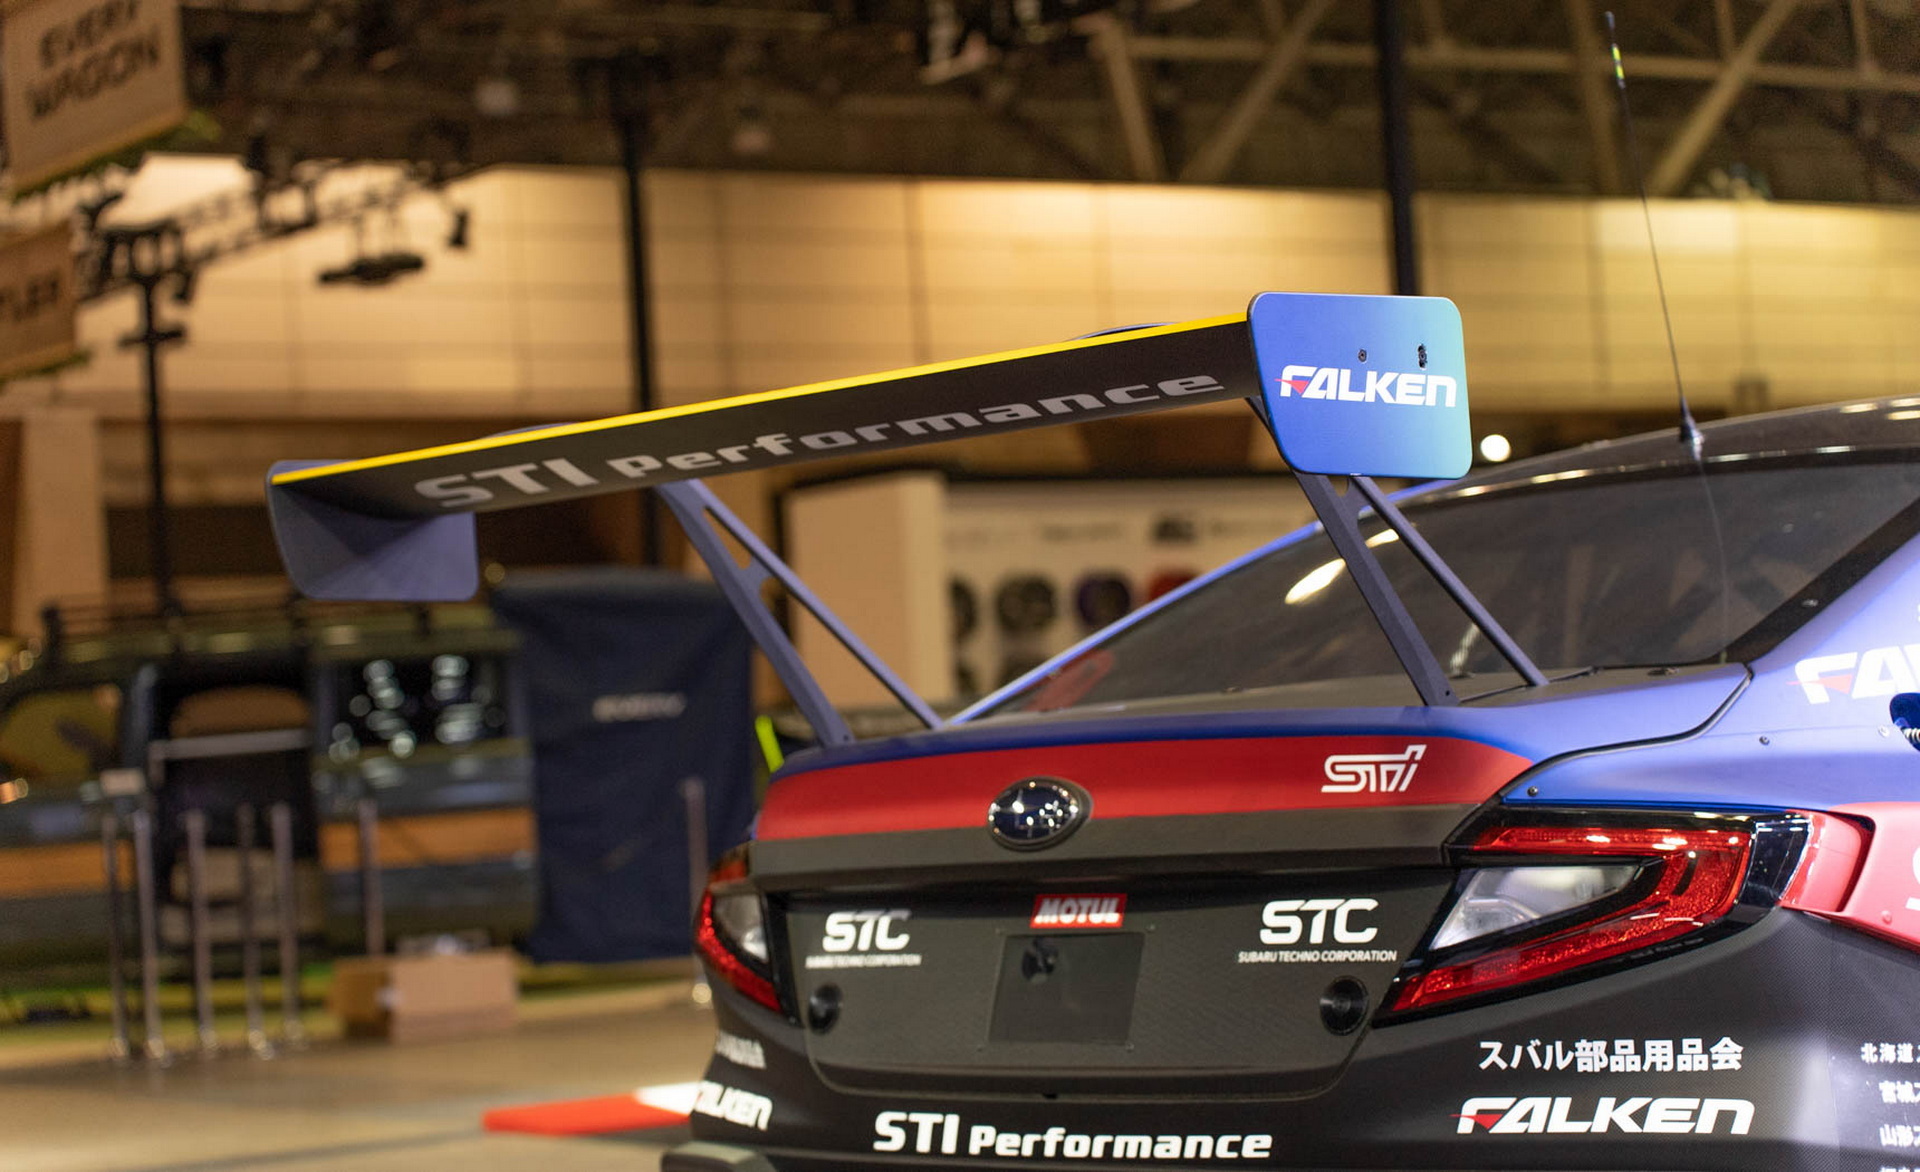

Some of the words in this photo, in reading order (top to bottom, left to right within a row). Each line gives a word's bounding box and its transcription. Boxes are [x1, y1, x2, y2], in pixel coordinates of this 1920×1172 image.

[1274, 365, 1457, 407] FALKEN
[414, 457, 600, 507] STI
[606, 374, 1225, 478] Performance
[822, 909, 911, 952] STC
[1033, 897, 1121, 924] MOTUL
[1259, 898, 1379, 945] STC
[1238, 951, 1278, 963] SUBARU
[1279, 951, 1321, 963] TECHNO
[1321, 950, 1397, 962] CORPORATION
[1478, 1036, 1744, 1073] スバル部品用品会
[1861, 1042, 1920, 1064] 北海道
[873, 1111, 960, 1154] STI
[968, 1125, 1273, 1159] Performance
[1450, 1097, 1756, 1135] FALKEN
